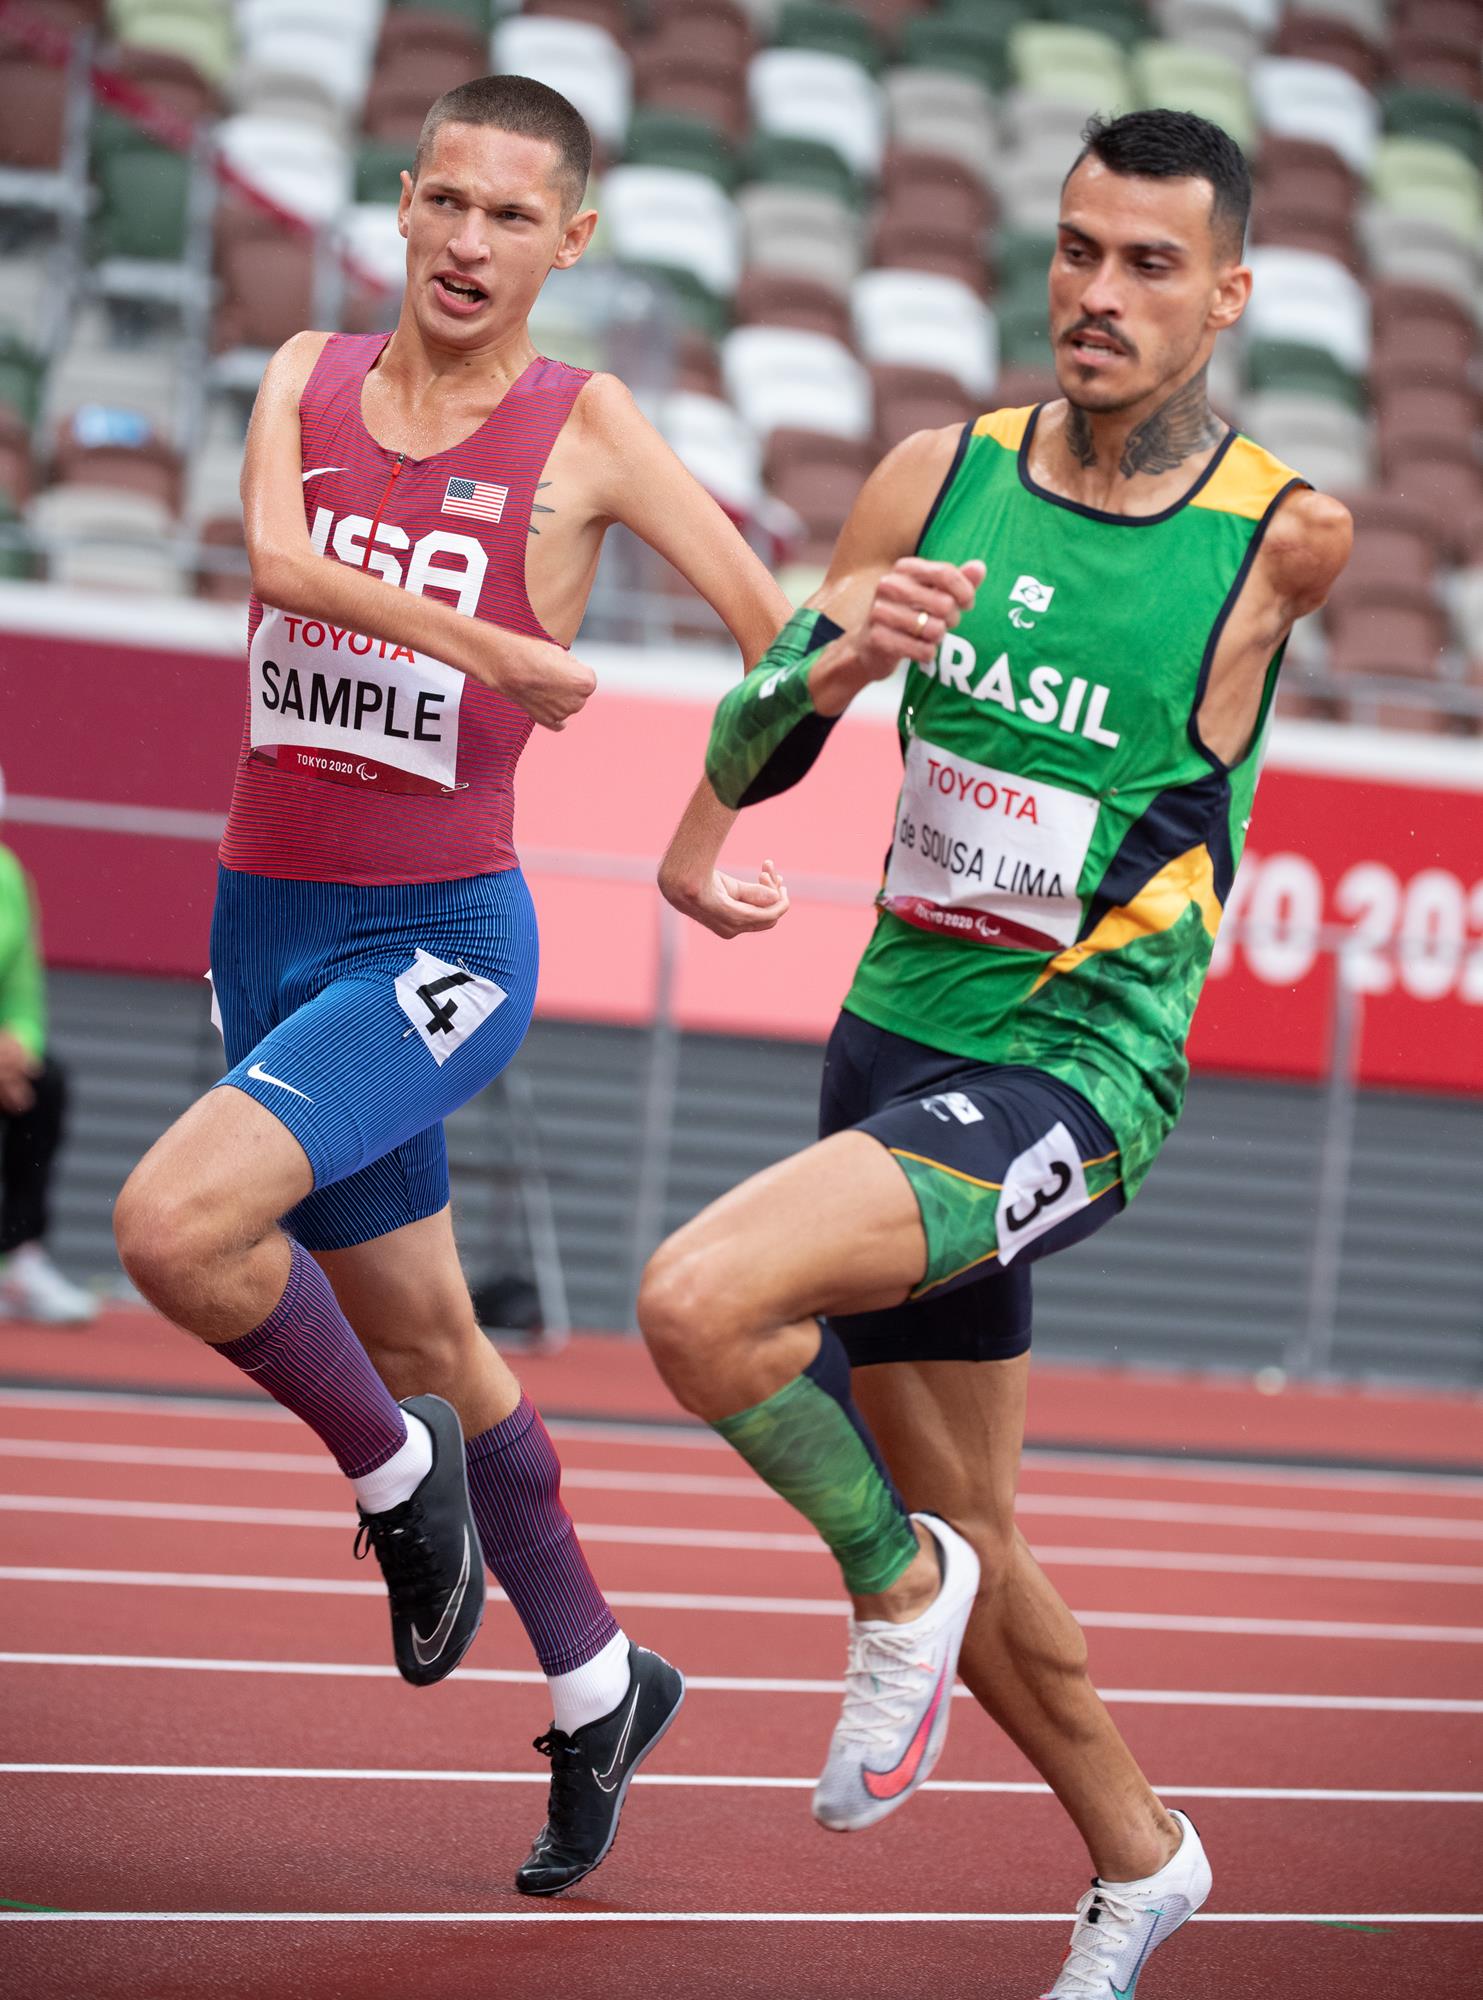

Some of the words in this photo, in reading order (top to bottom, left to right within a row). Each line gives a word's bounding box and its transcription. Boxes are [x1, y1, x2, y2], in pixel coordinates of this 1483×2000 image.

[261, 660, 446, 742] SAMPLE
[917, 632, 1120, 748] RASIL
[297, 753, 327, 769] TOKYO
[329, 760, 353, 774] 2020
[928, 759, 1038, 824] TOYOTA
[900, 813, 916, 849] de
[921, 823, 985, 882] SOUSA
[994, 855, 1065, 899] LIMA
[1335, 861, 1483, 1006] 20
[415, 971, 475, 1035] 4
[1005, 1160, 1072, 1232] 3
